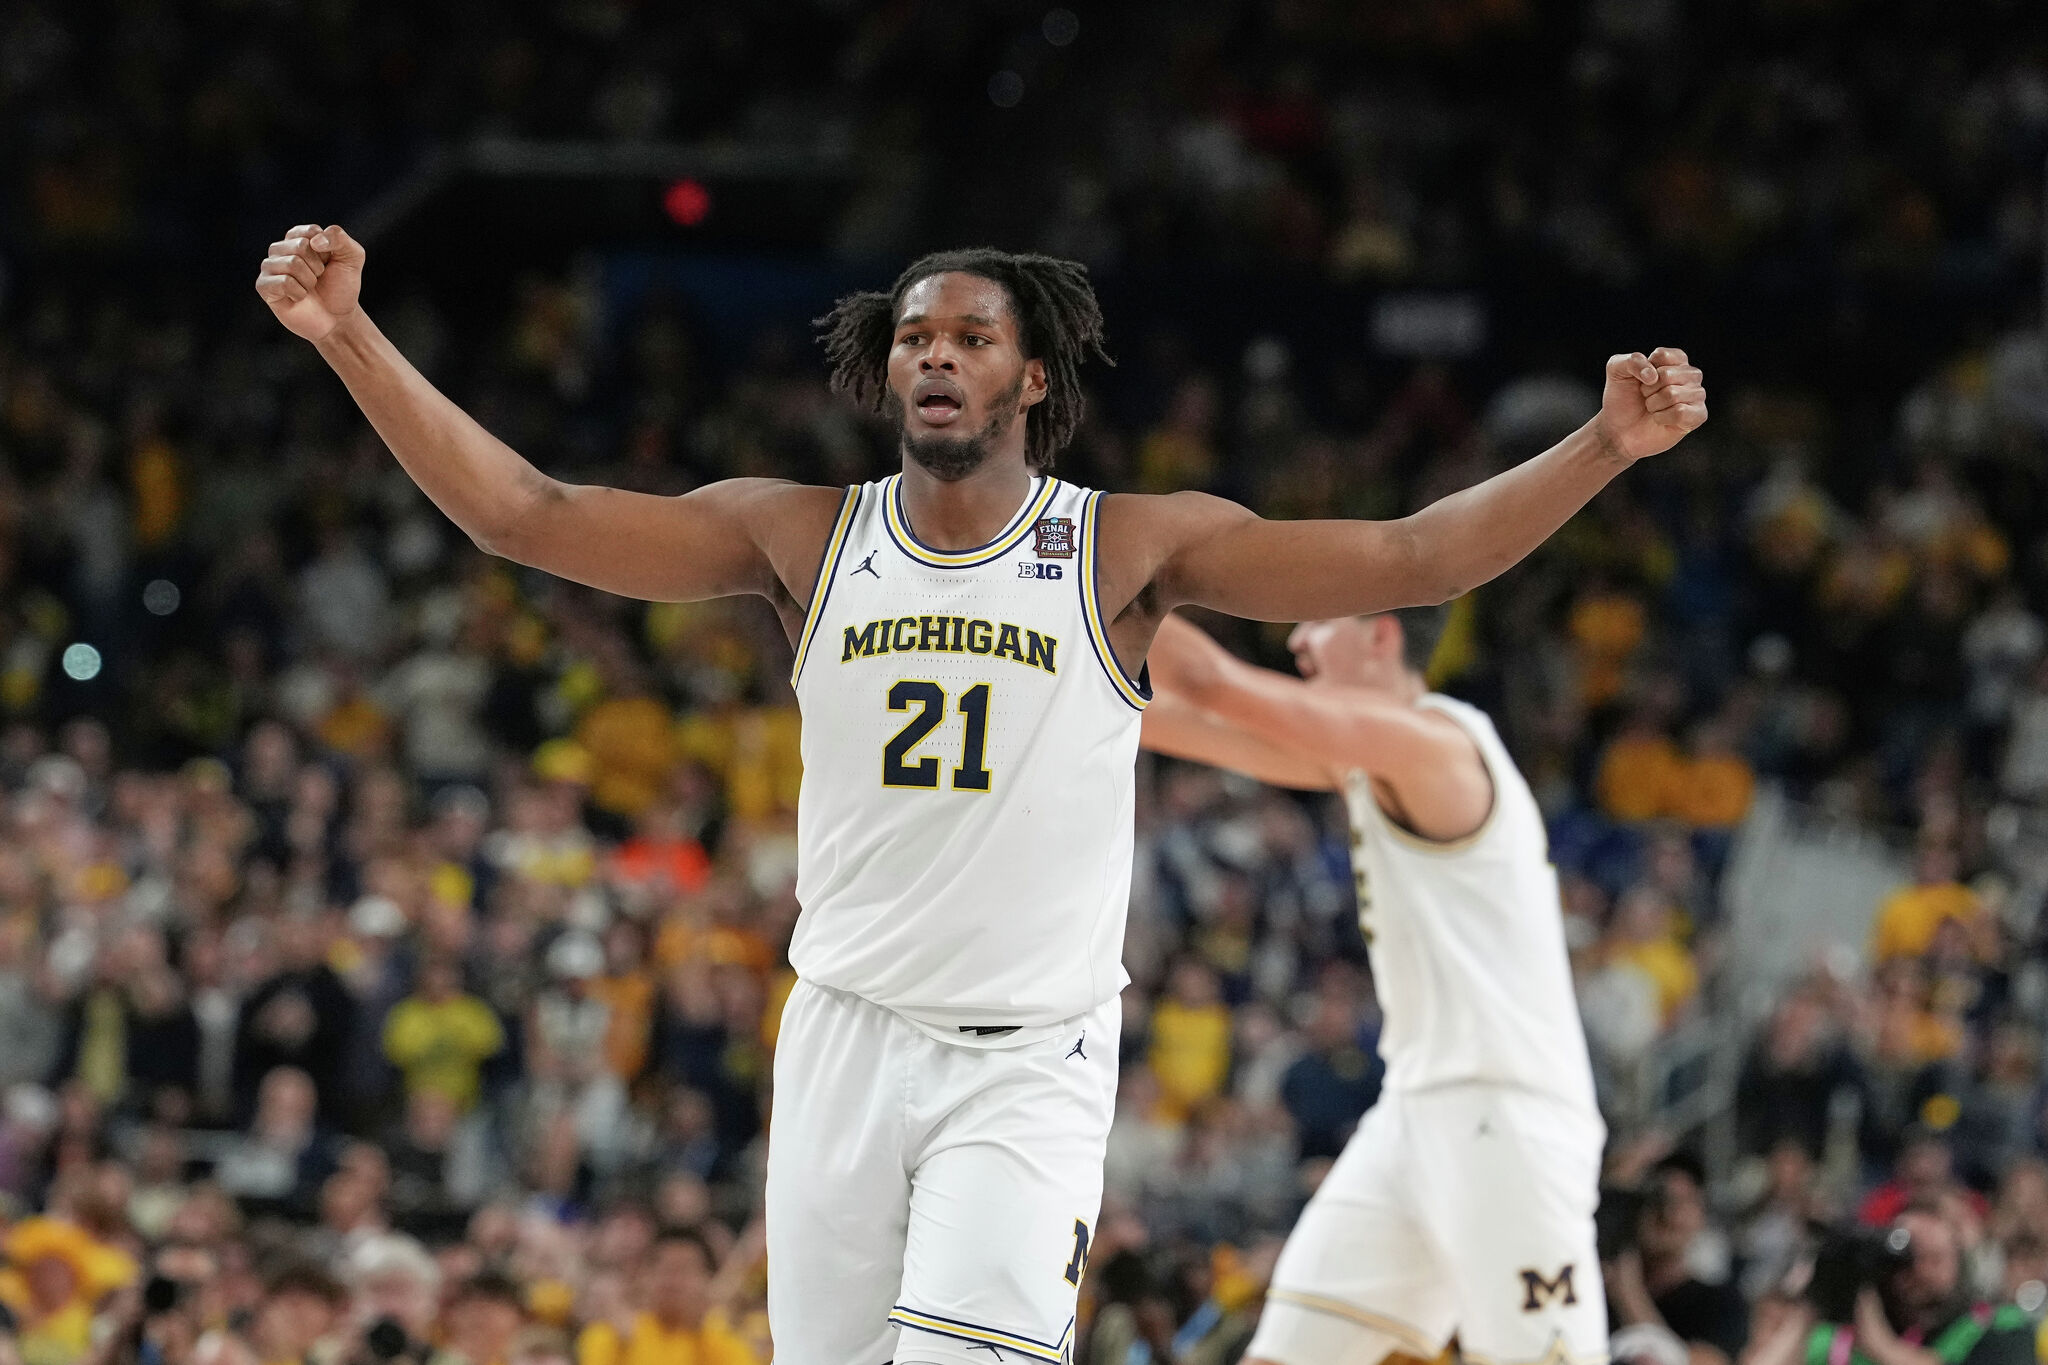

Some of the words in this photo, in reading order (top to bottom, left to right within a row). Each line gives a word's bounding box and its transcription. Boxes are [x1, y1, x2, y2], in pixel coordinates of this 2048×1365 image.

[1040, 525, 1069, 533] FINAL
[1041, 542, 1069, 551] FOUR
[841, 617, 1057, 675] MICHIGAN
[881, 679, 992, 793] 21
[1519, 1265, 1577, 1310] M
